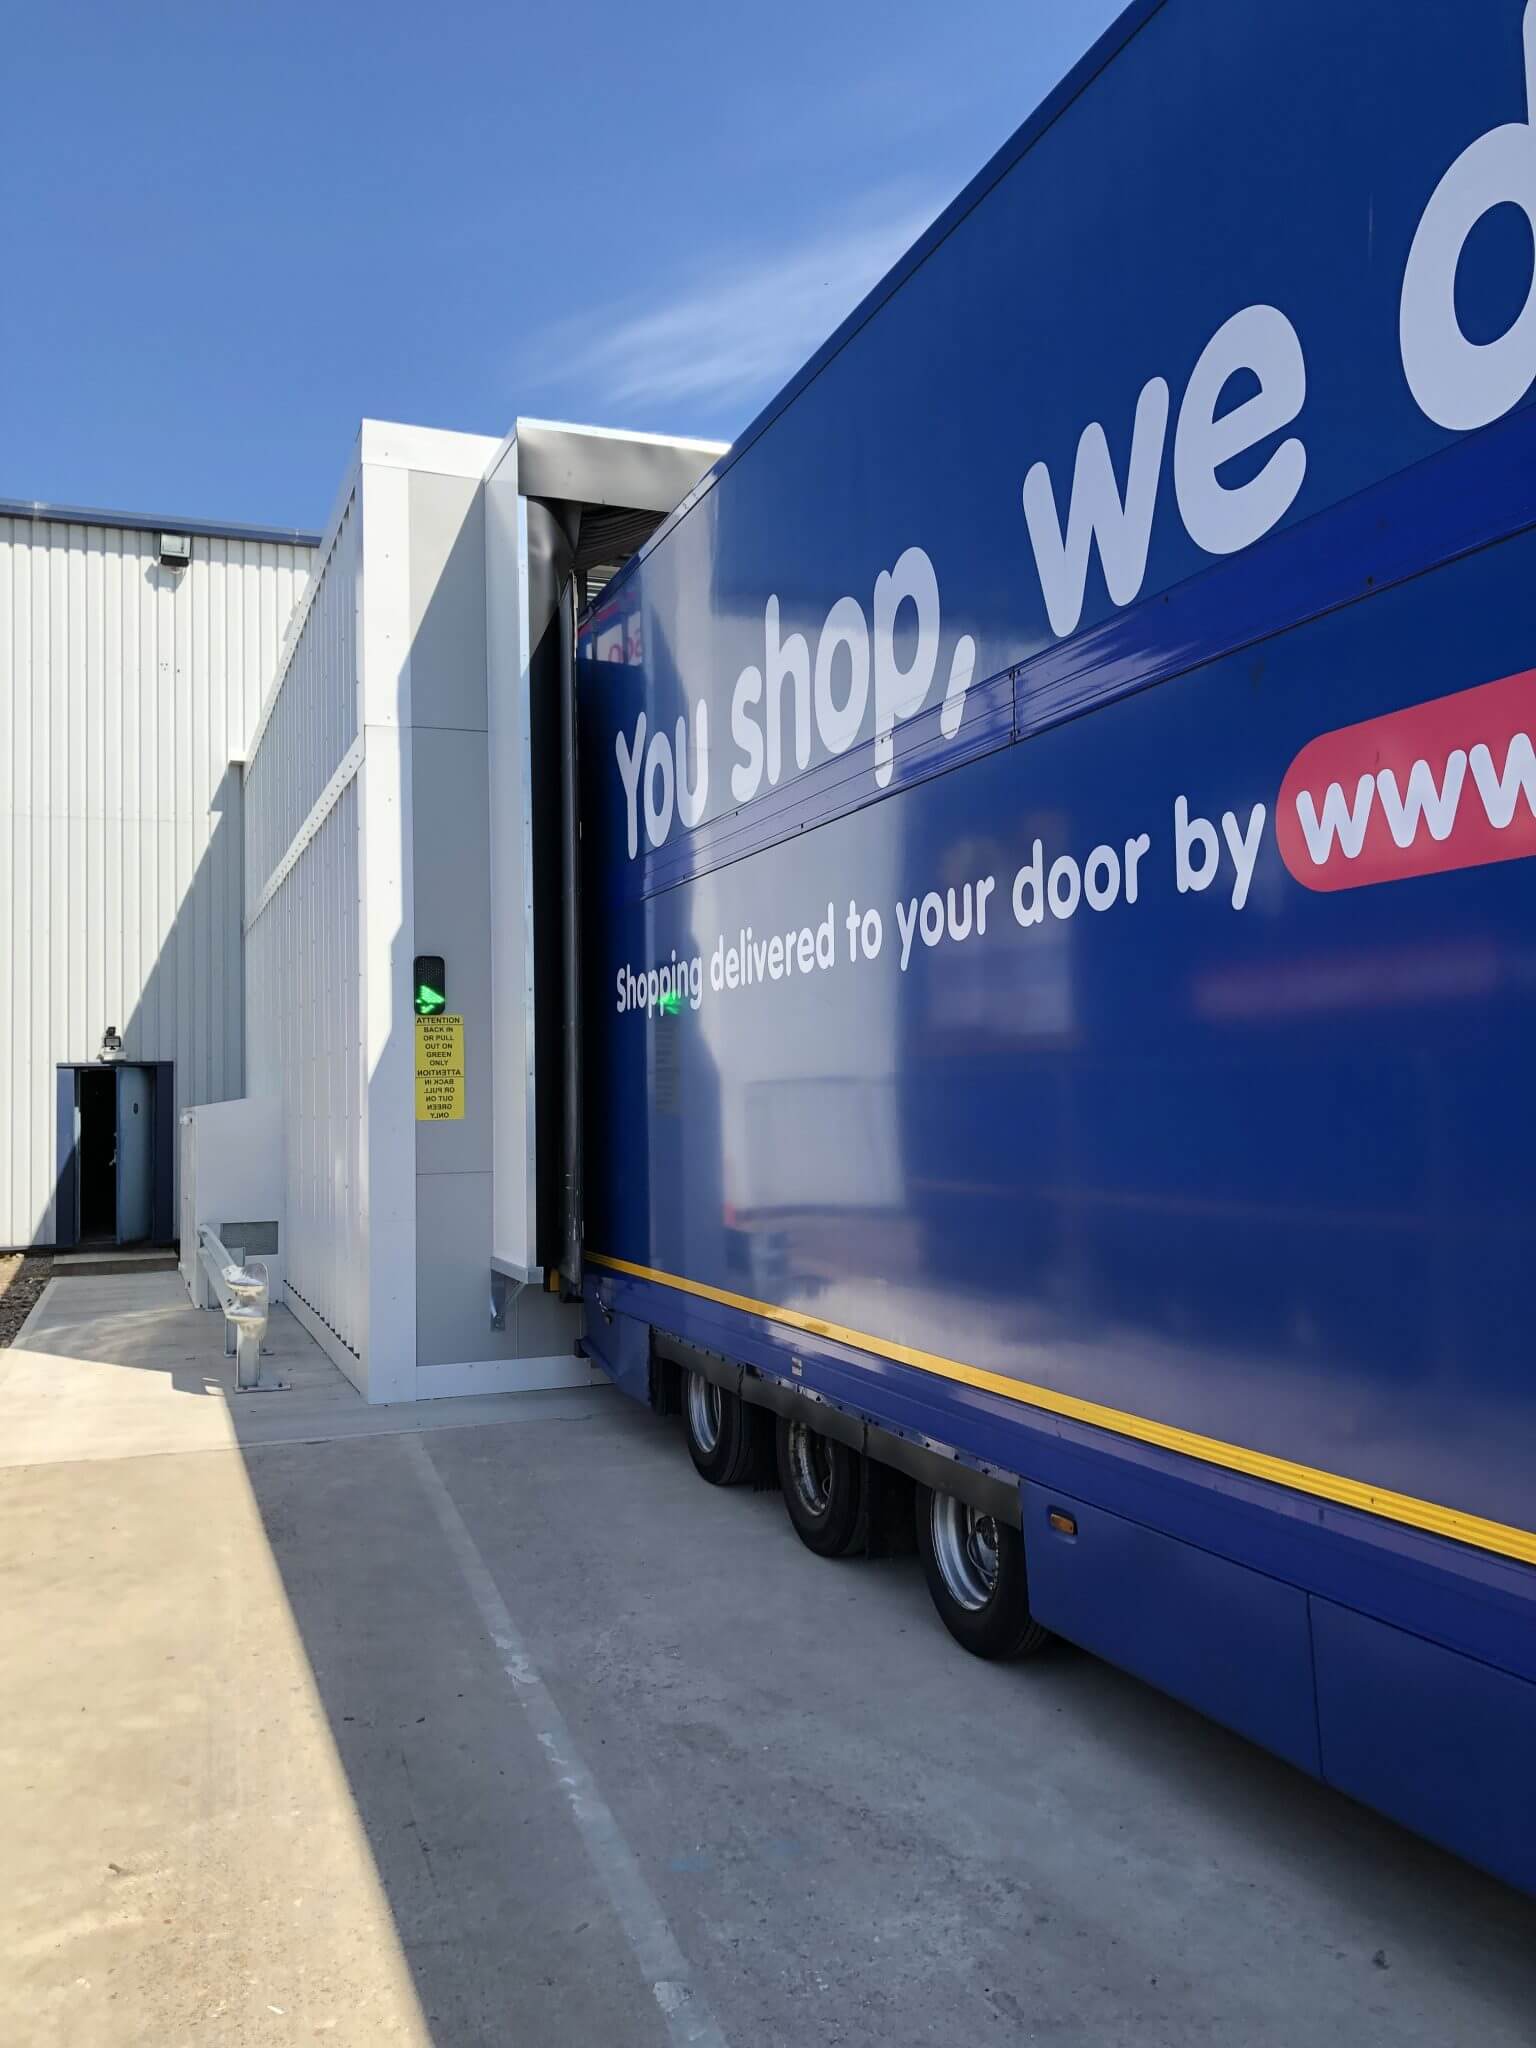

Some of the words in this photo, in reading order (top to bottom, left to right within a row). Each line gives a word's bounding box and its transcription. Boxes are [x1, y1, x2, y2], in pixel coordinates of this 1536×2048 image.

[615, 698, 709, 859] You
[731, 547, 976, 802] shop,
[1022, 304, 1306, 638] we
[616, 950, 702, 1019] Shopping
[710, 902, 834, 991] delivered
[846, 900, 882, 963] to
[896, 876, 995, 972] your
[1012, 838, 1150, 927] door
[1174, 795, 1266, 910] by
